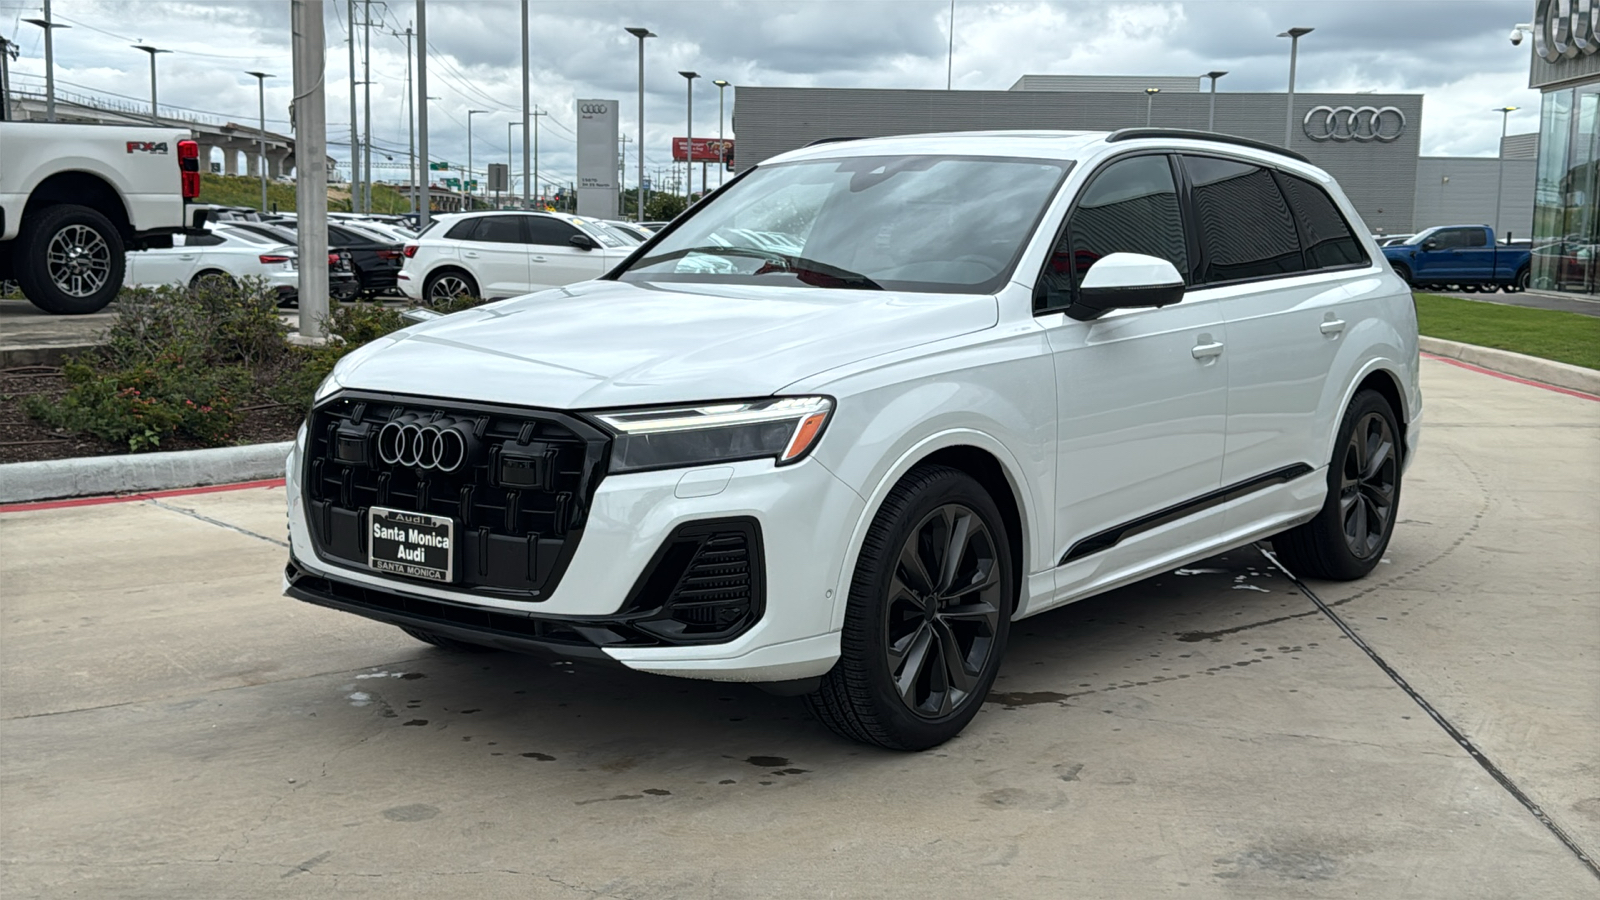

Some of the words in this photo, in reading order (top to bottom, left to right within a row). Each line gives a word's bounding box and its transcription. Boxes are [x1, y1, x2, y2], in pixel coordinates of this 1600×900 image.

[126, 141, 168, 154] FX4
[395, 514, 424, 523] Audi
[373, 523, 405, 542] Santa
[408, 528, 449, 549] Monica
[397, 544, 425, 562] Audi
[377, 561, 404, 572] SANTA
[407, 566, 441, 578] MONICA
